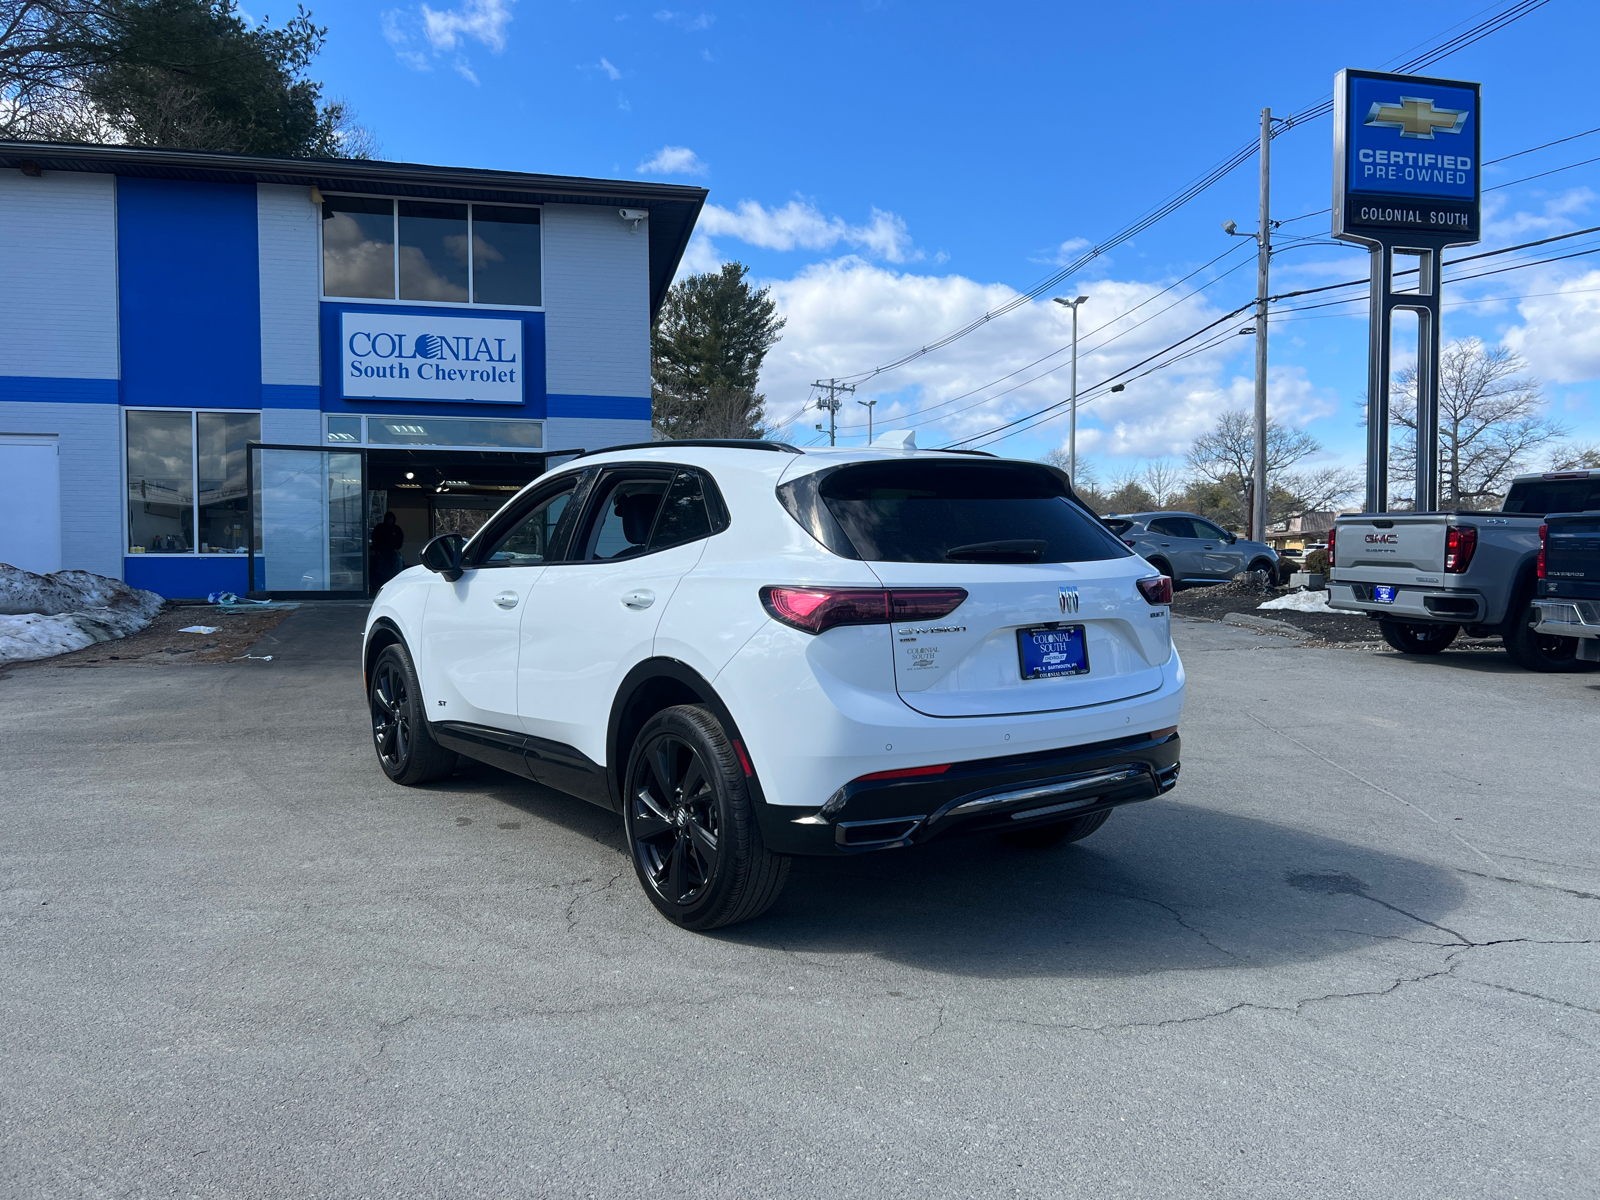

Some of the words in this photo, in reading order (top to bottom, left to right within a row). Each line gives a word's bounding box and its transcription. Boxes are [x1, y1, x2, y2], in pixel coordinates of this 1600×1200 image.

[1359, 149, 1471, 170] CERTIFIED
[1364, 165, 1466, 184] PRE-OWNED
[1361, 207, 1422, 223] COLONIAL
[1430, 211, 1468, 226] SOUTH
[349, 331, 516, 363] COLONIAL
[350, 360, 410, 379] South
[417, 363, 516, 383] Chevrolet
[1365, 534, 1398, 544] GMC
[898, 625, 967, 635] ENVISION
[1033, 633, 1071, 645] COLONIAL
[1040, 642, 1067, 653] SOUTH
